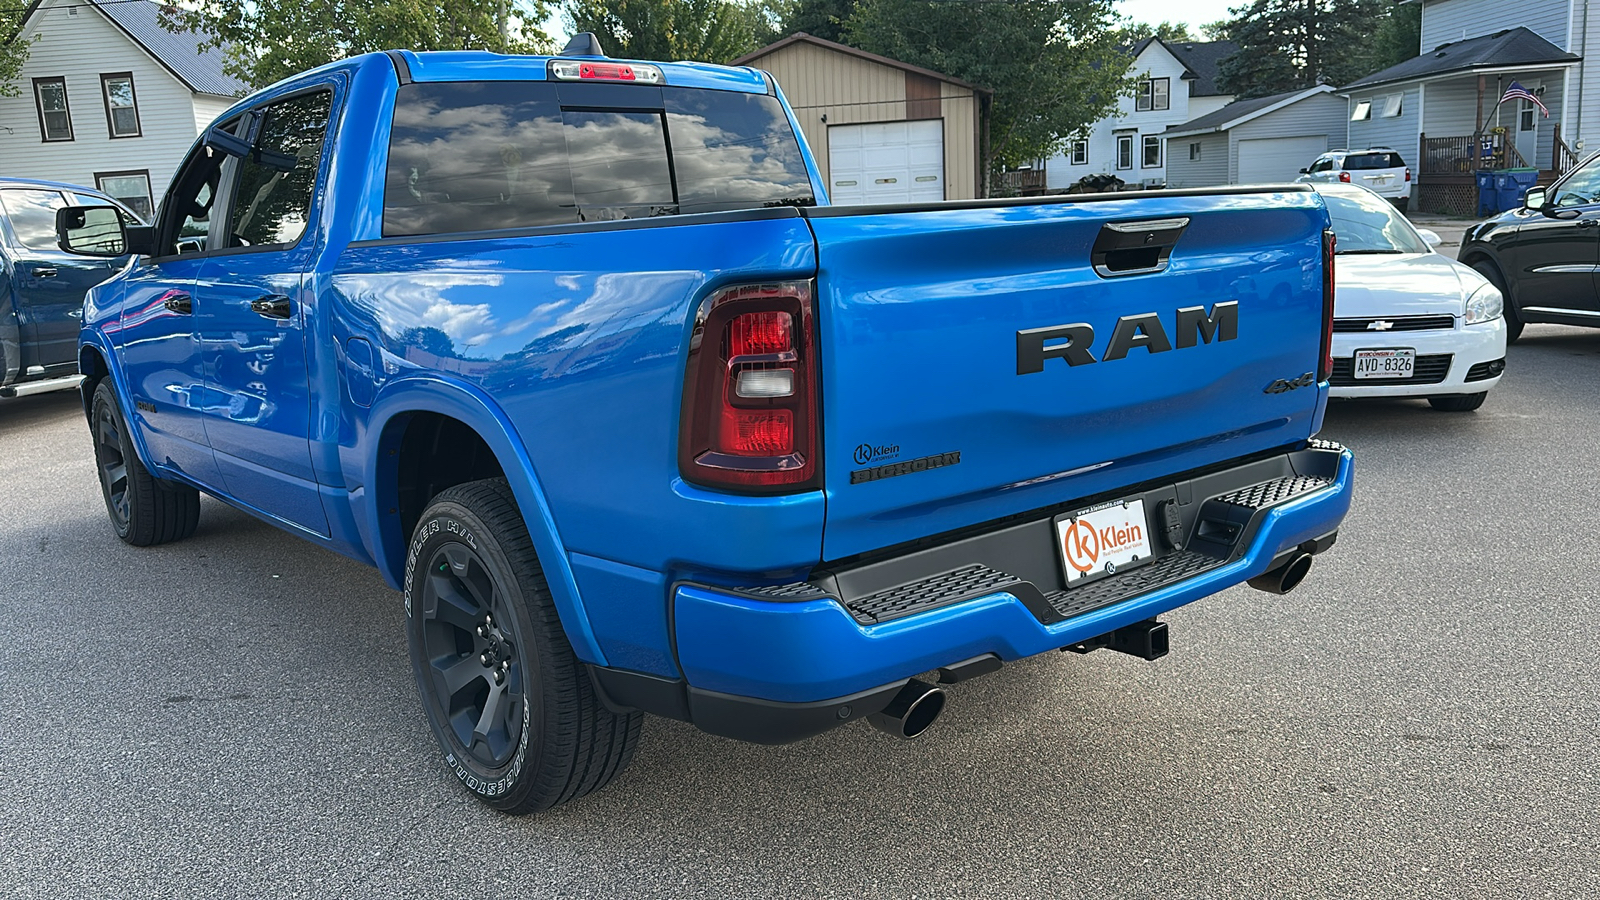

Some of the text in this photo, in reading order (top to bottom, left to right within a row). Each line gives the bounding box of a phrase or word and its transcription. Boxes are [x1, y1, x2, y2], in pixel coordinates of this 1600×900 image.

[1016, 300, 1239, 376] RAM
[1358, 358, 1412, 372] AVD-8326
[873, 444, 900, 456] Klein
[850, 451, 960, 484] BIGHORN
[1100, 522, 1142, 550] Klein
